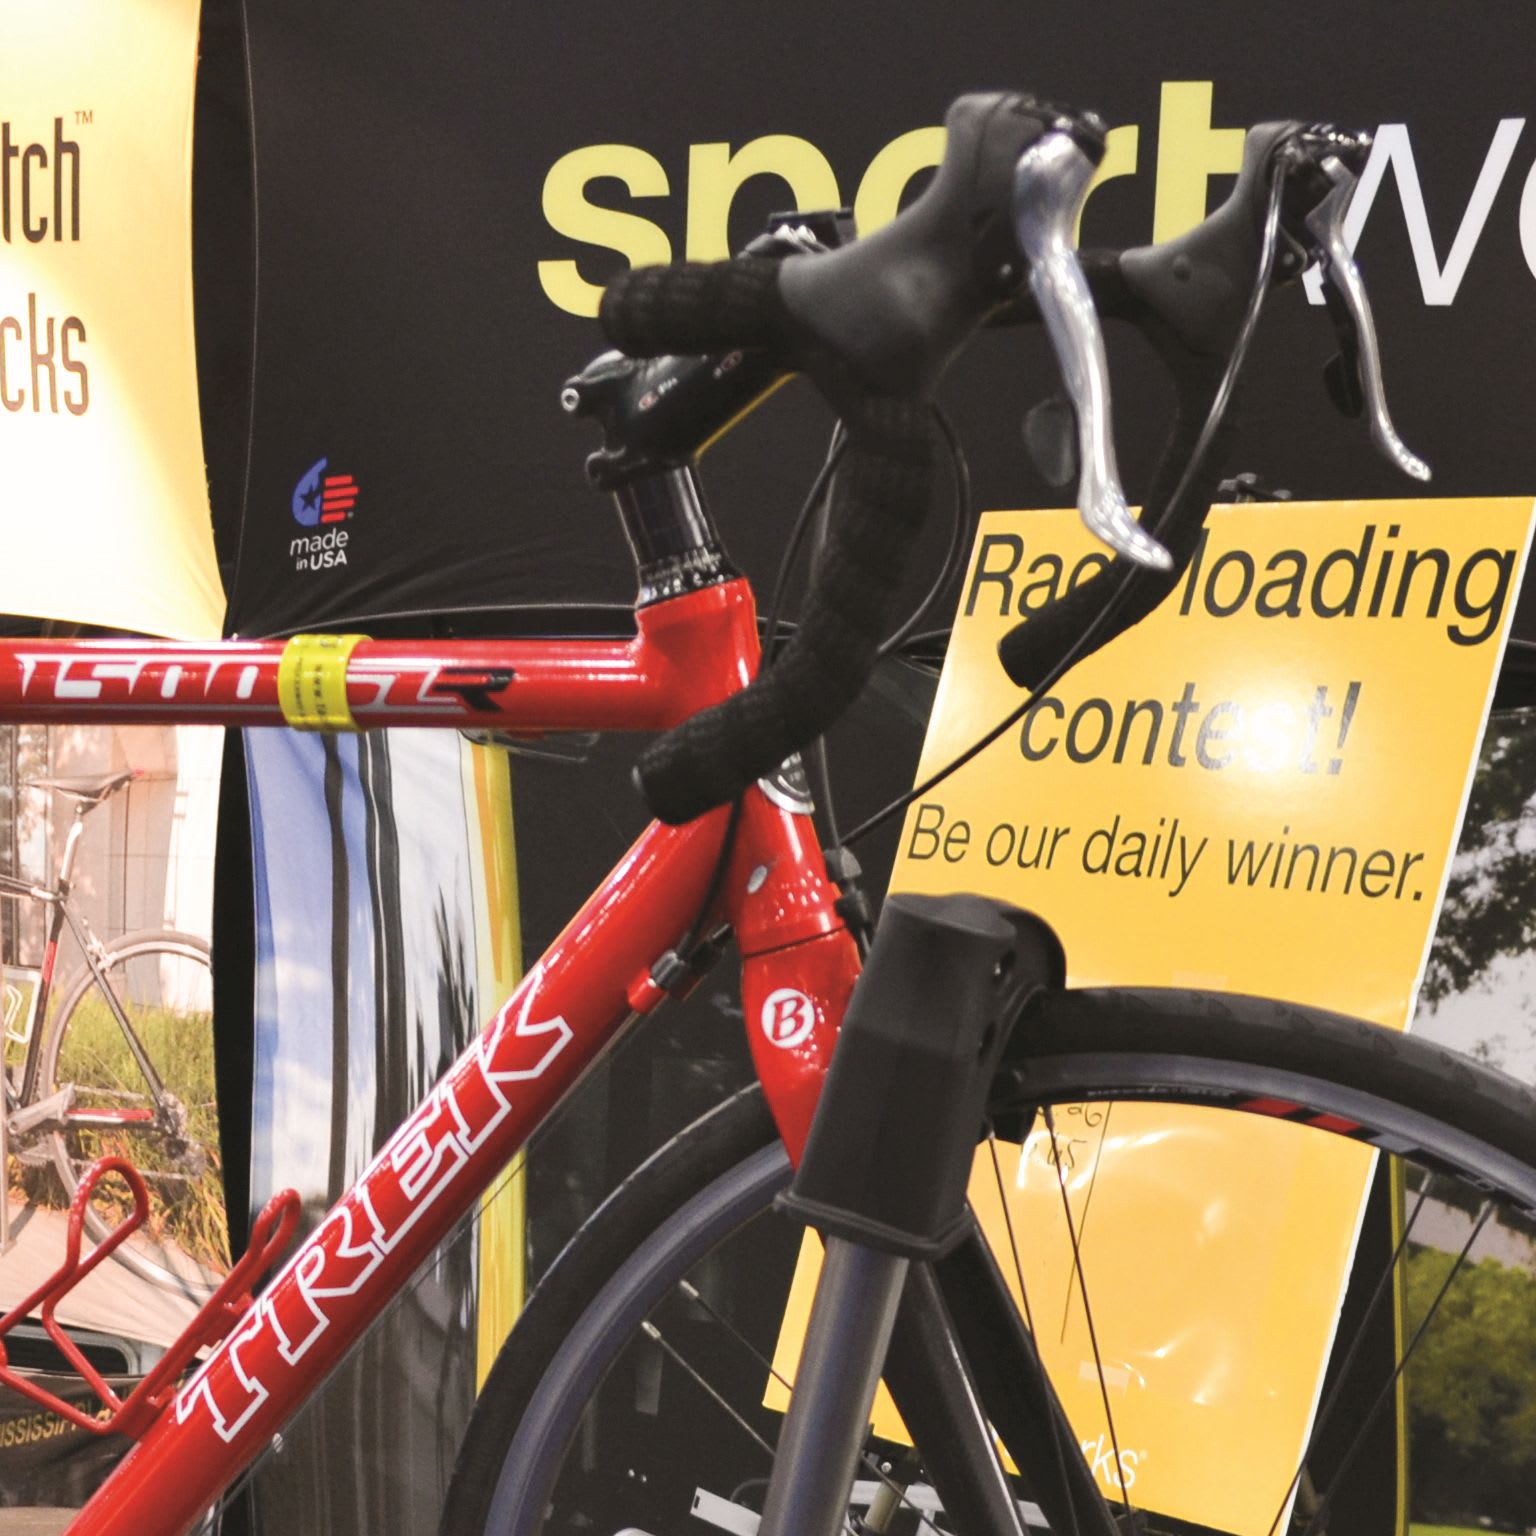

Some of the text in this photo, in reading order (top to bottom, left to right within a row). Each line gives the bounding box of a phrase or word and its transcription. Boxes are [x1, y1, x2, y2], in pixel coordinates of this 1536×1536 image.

[289, 527, 349, 556] made
[296, 549, 348, 571] in USA
[1179, 524, 1517, 646] loading
[1019, 682, 1362, 776] contest!
[907, 804, 1427, 902] Be our daily winner.
[176, 968, 574, 1444] TREK
